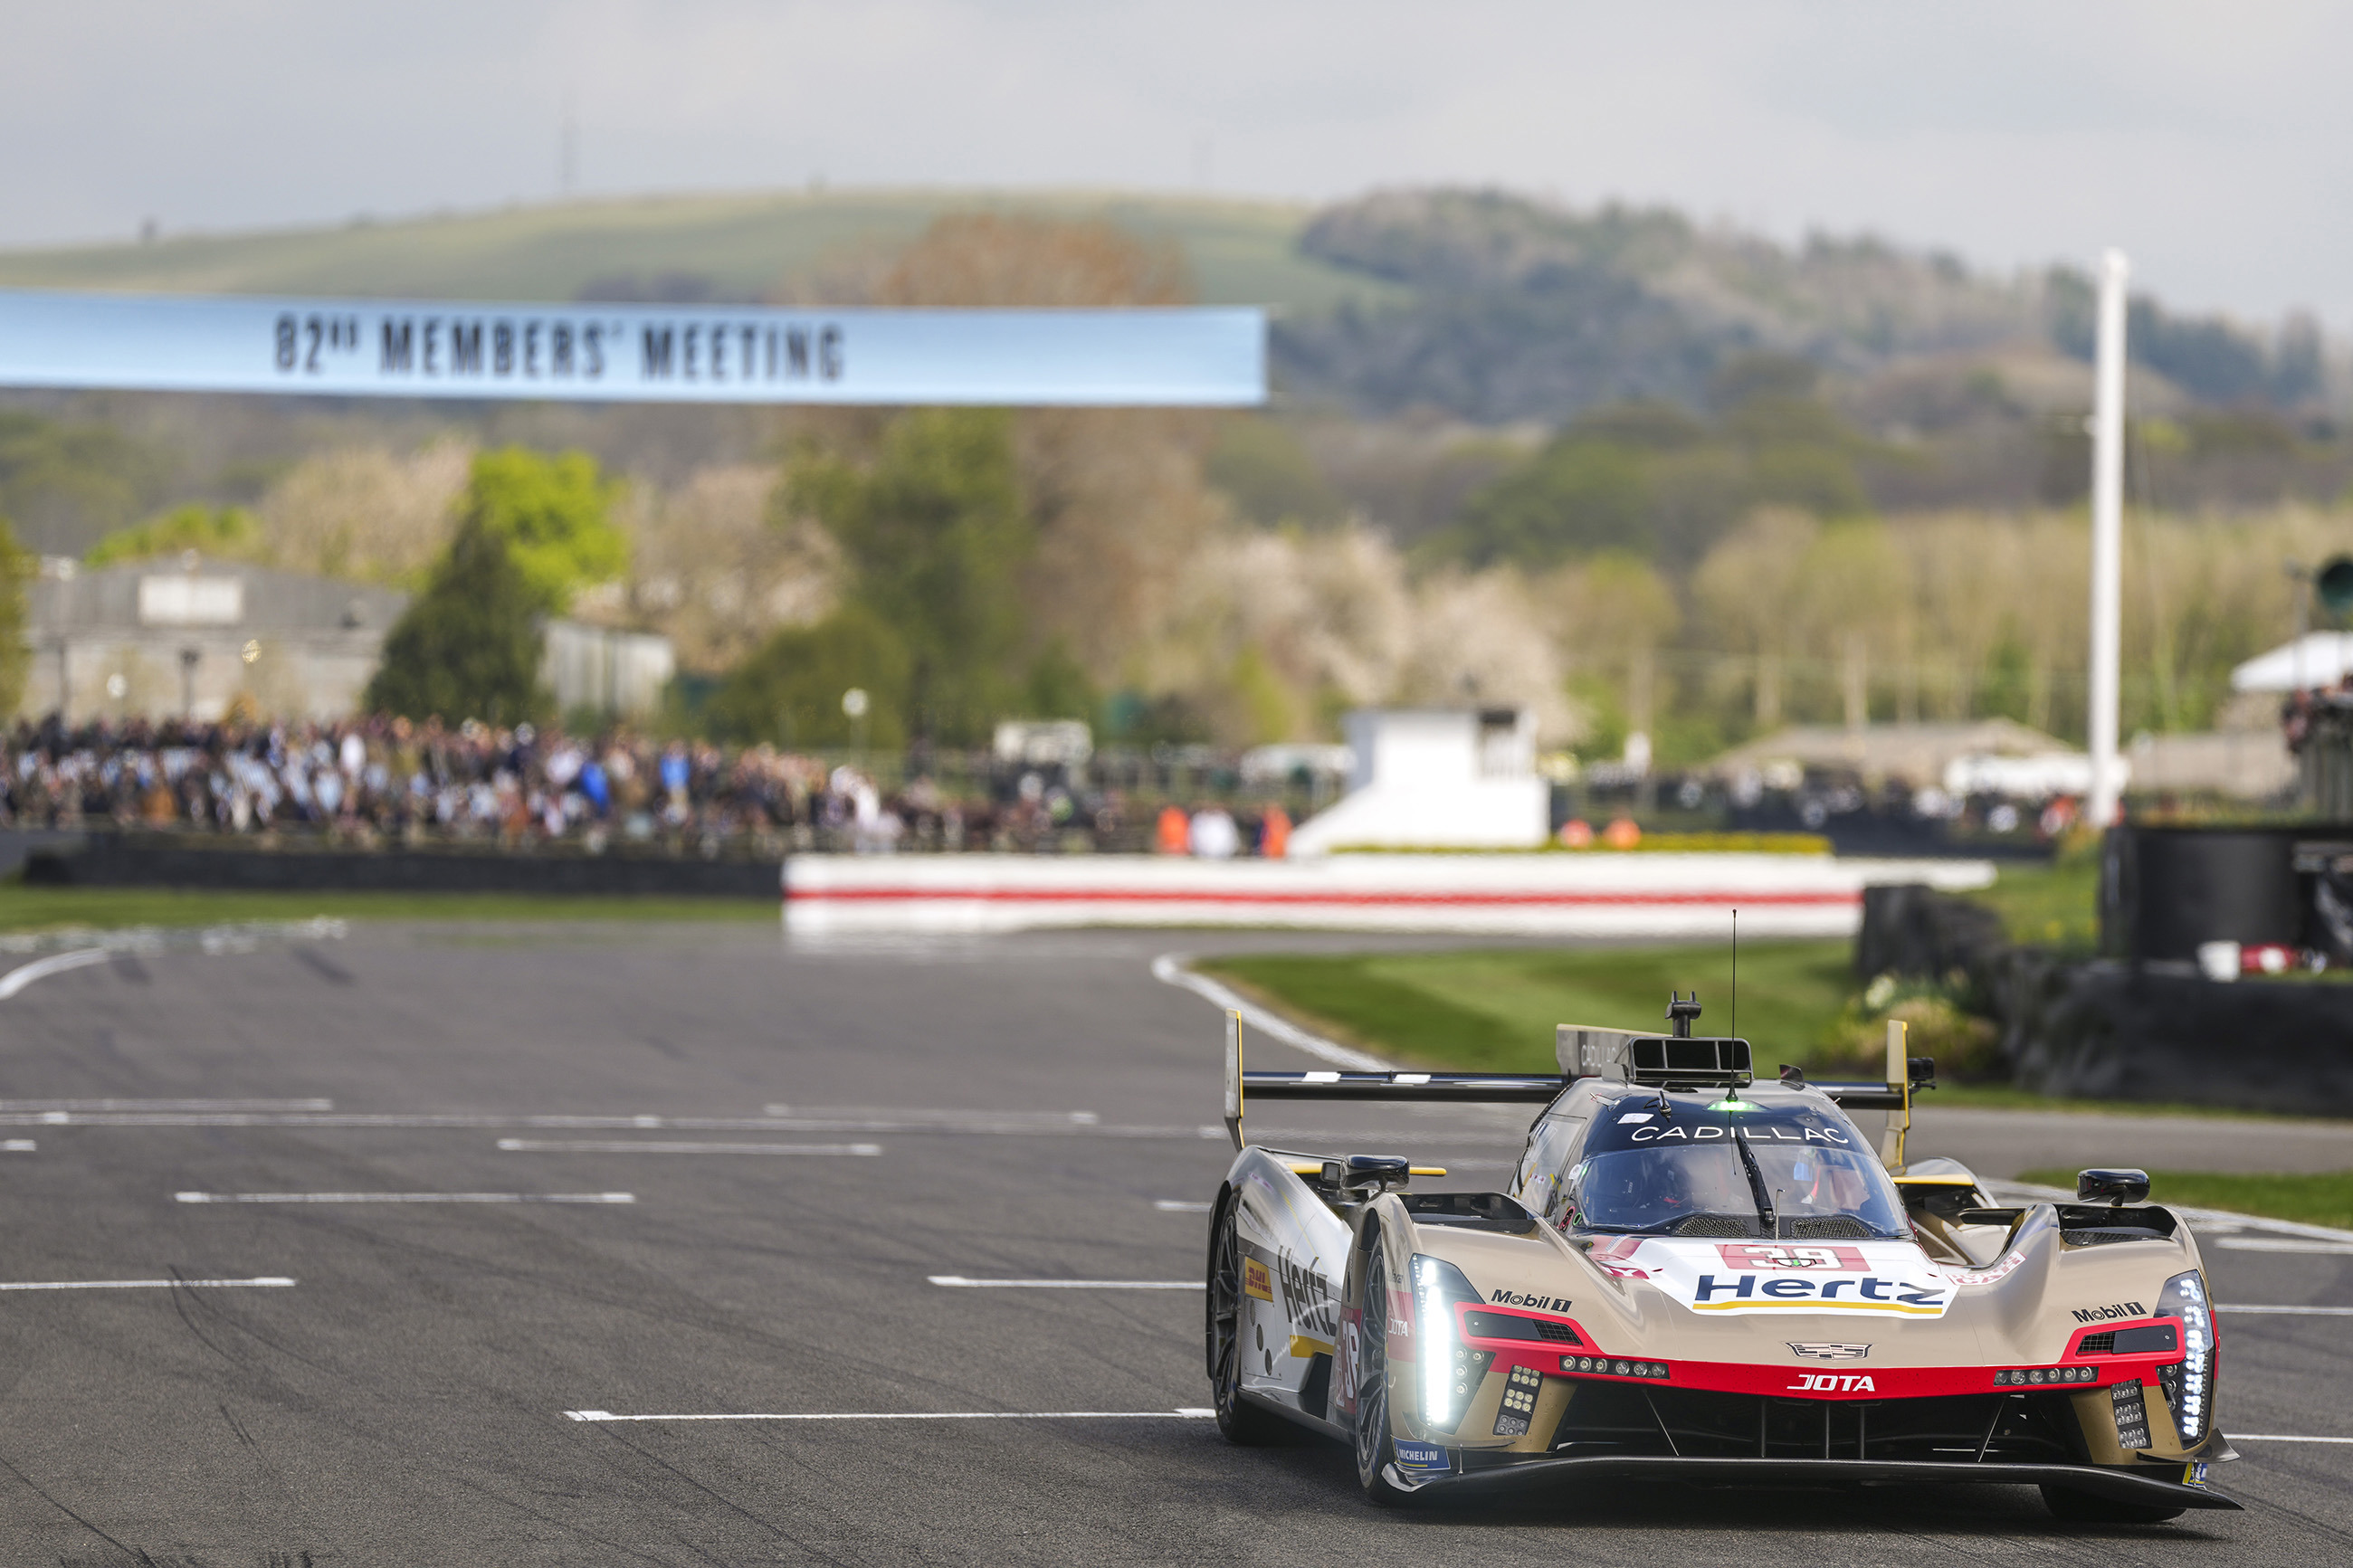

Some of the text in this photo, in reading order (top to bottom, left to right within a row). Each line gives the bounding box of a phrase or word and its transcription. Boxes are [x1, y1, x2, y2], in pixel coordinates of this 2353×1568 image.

[639, 320, 846, 381] MEETING
[1631, 1126, 1849, 1144] CADILLAC
[1247, 1266, 1269, 1292] DHL
[1694, 1274, 1946, 1306] Hertz
[1277, 1245, 1338, 1337] Hertz
[1491, 1288, 1573, 1313] Mobil 1
[2071, 1301, 2148, 1323] Mobil 1
[1388, 1317, 1409, 1336] JOTA
[1786, 1373, 1876, 1392] JOTA
[1398, 1448, 1438, 1461] MICHELIN
